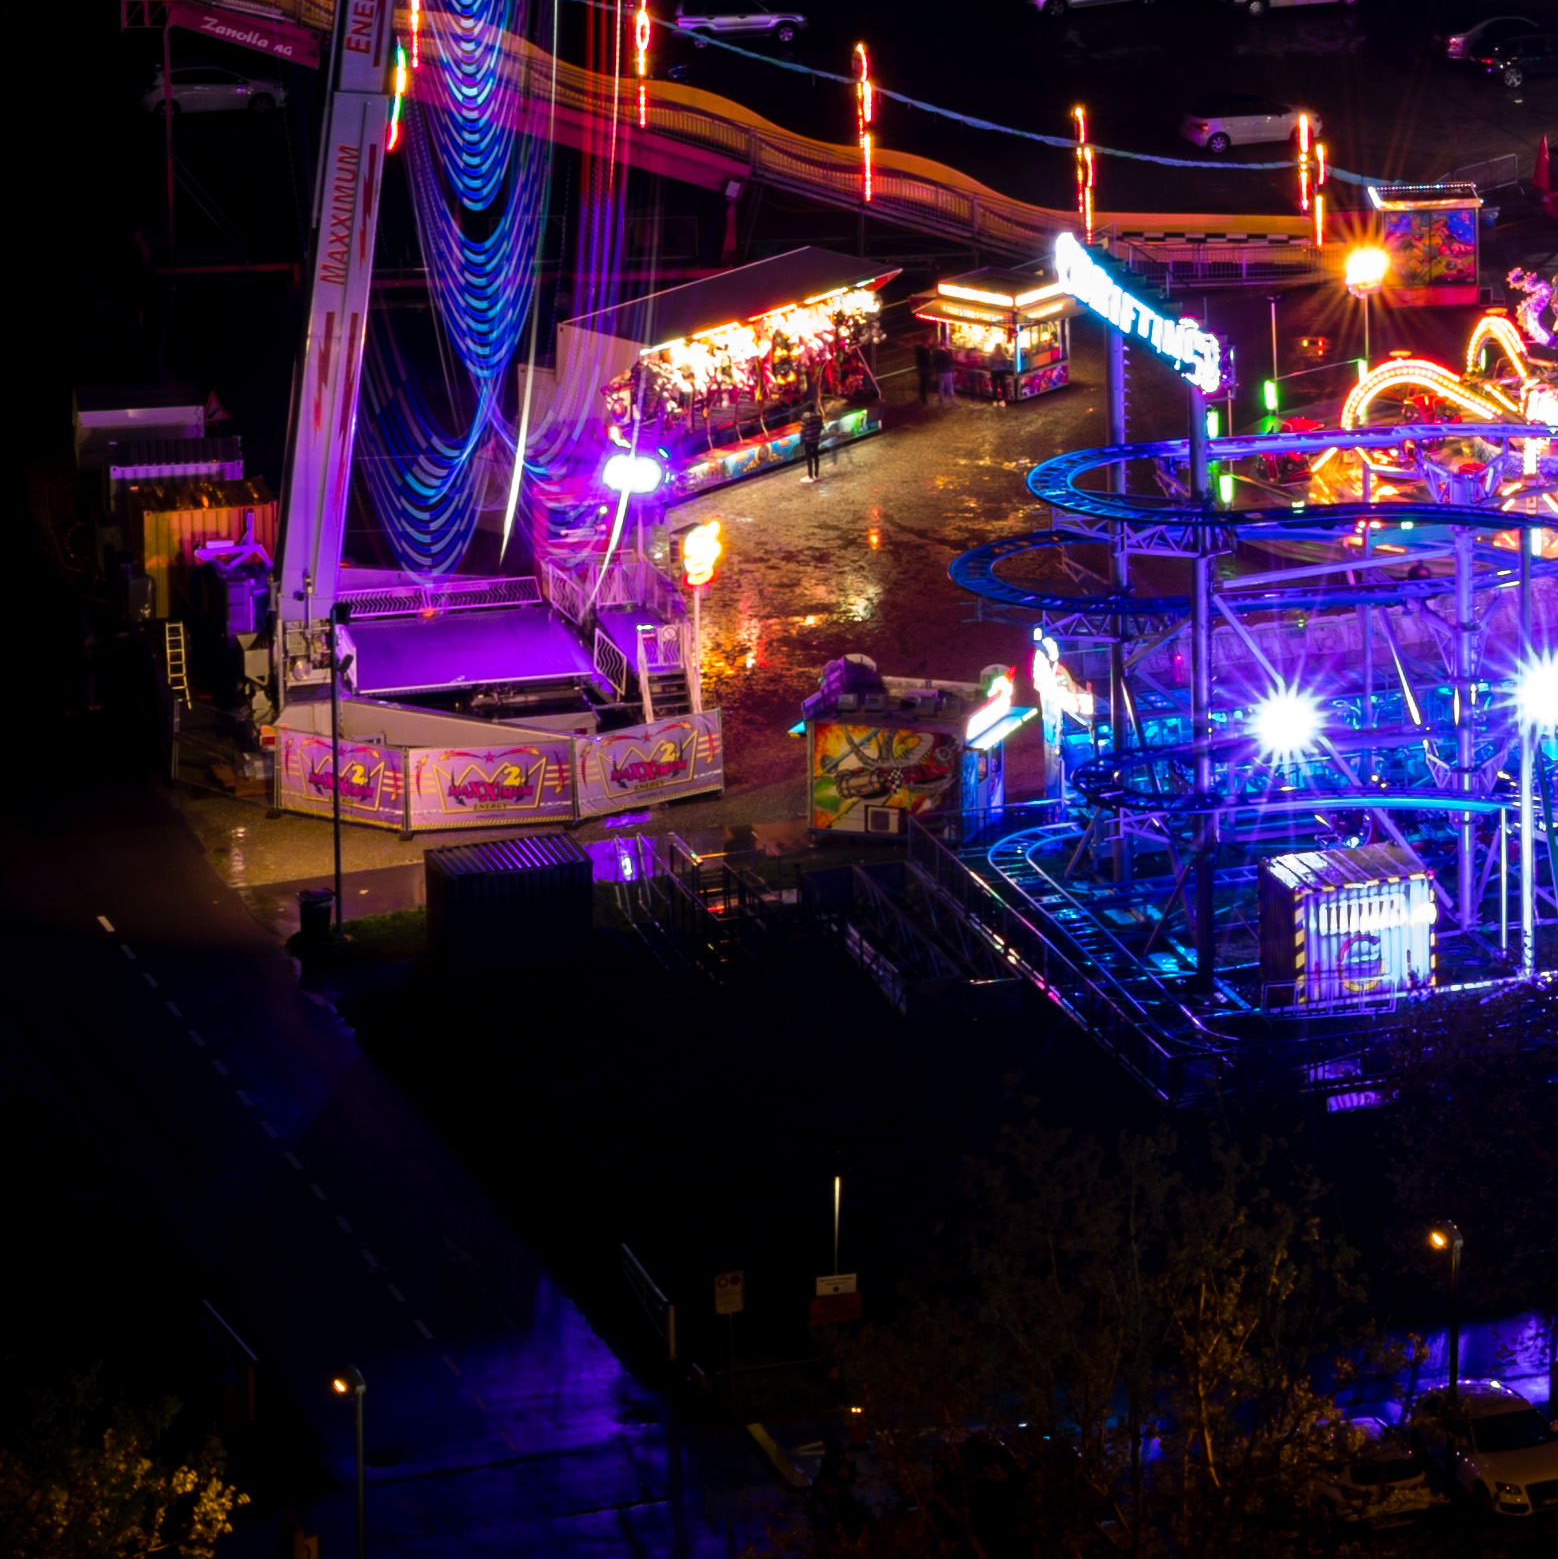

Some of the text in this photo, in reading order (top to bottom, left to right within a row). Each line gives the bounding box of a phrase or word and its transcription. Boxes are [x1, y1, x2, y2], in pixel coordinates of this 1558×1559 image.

[201, 16, 293, 56] Zanolla AG
[319, 143, 361, 286] MAXXIMUM
[351, 764, 368, 786] 2
[611, 742, 687, 782] MAXXIMUM 2
[447, 766, 533, 802] MAXXIMUM 2
